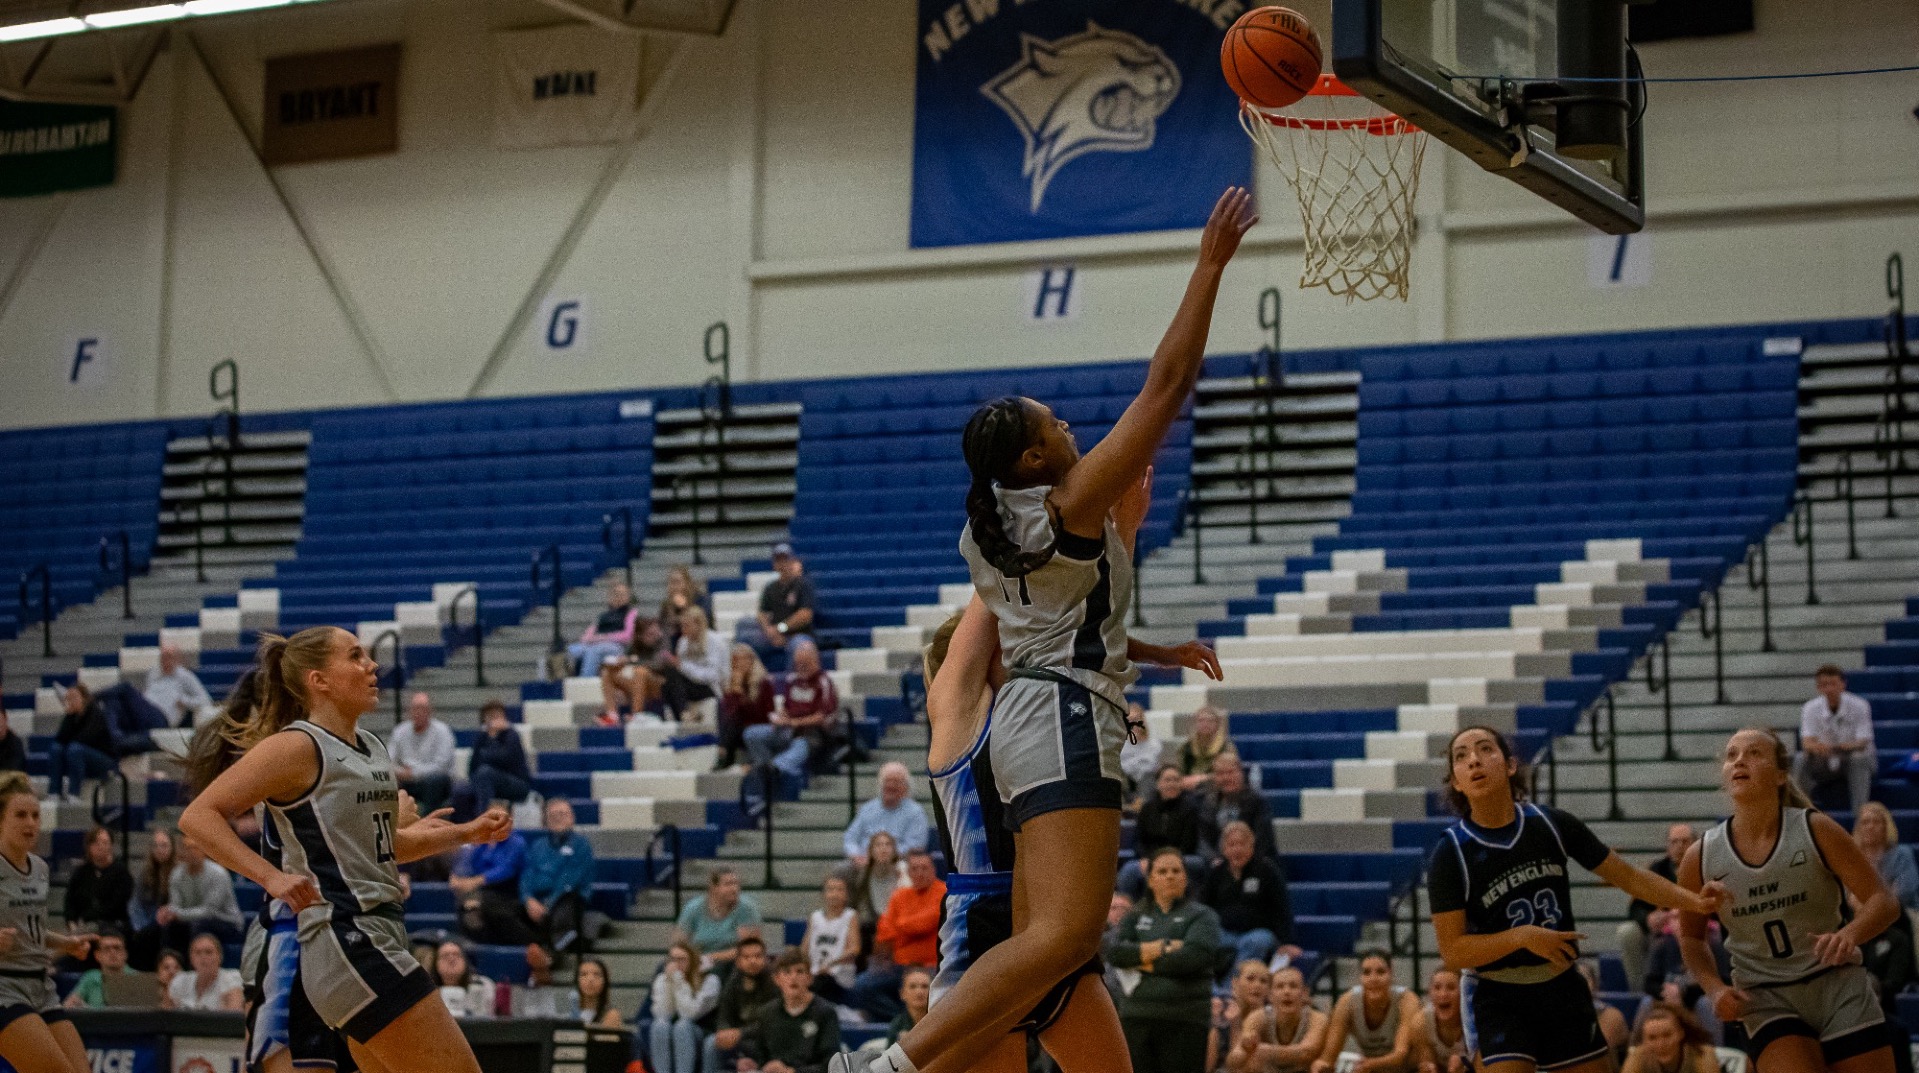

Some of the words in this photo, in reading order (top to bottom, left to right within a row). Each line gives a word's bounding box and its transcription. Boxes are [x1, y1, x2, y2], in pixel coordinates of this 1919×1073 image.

[924, 0, 999, 62] NEW
[279, 80, 381, 125] BRYANT
[1034, 267, 1075, 318] H
[547, 301, 581, 349] G
[70, 338, 99, 383] F
[371, 771, 391, 781] NEW
[1481, 878, 1509, 909] NEW
[1508, 863, 1563, 889] ENGLAND
[1731, 891, 1808, 918] HAMPSHIRE
[1748, 882, 1779, 898] NEW
[1505, 887, 1563, 931] 23
[1763, 918, 1794, 959] 0
